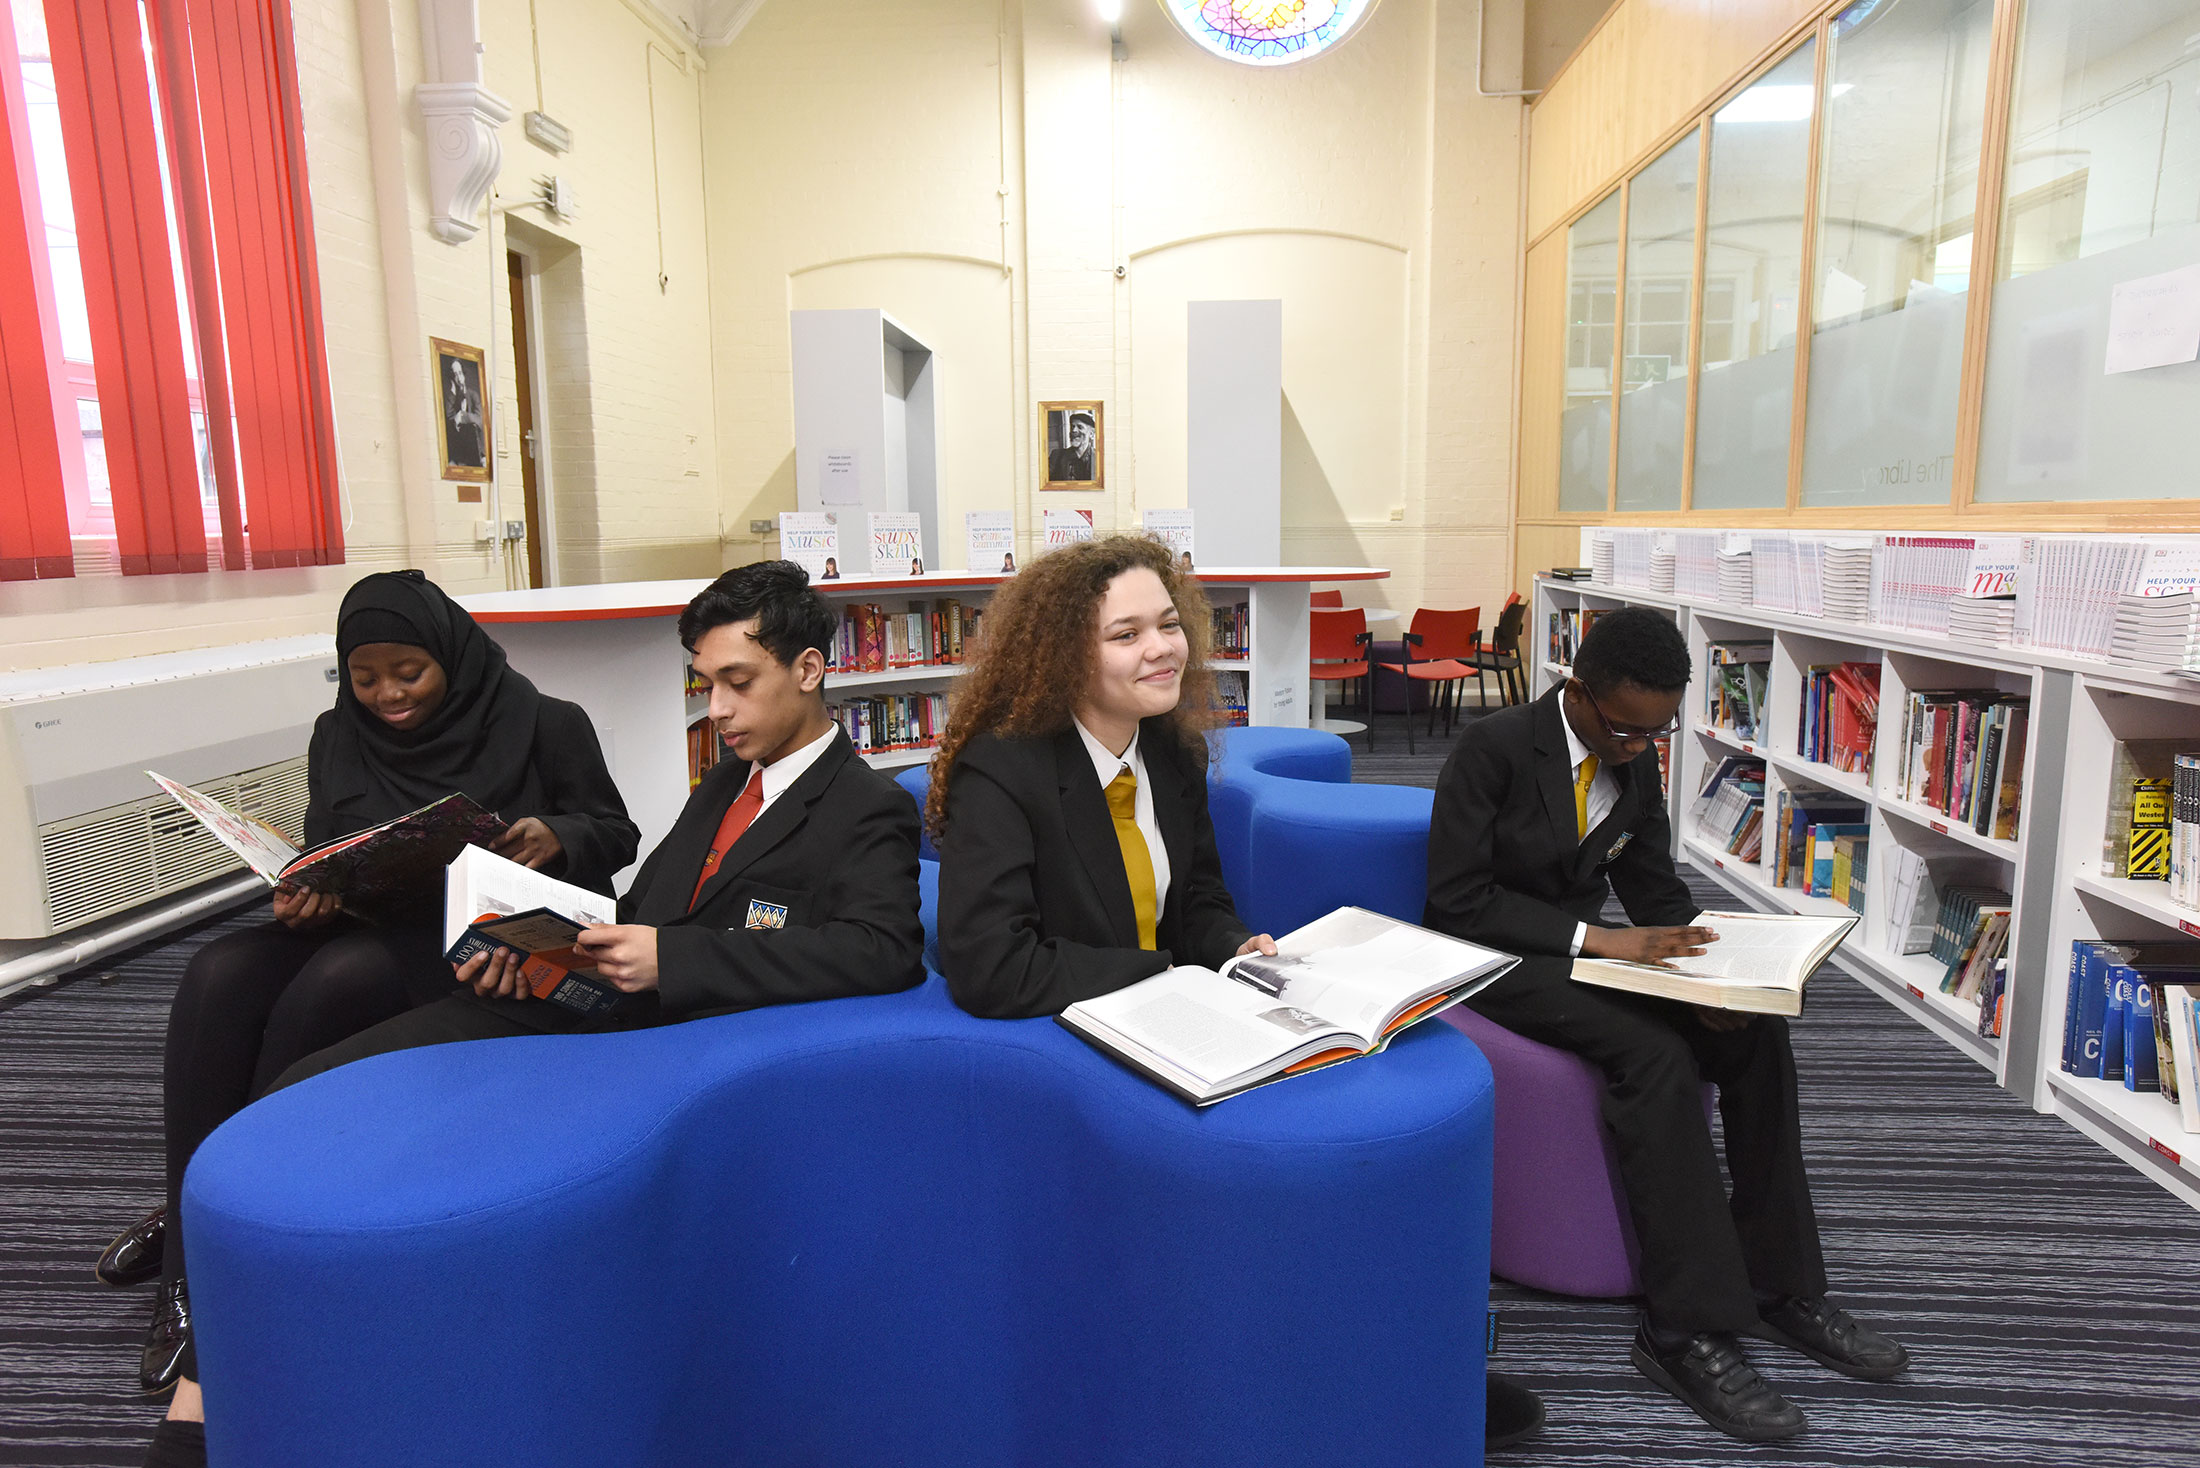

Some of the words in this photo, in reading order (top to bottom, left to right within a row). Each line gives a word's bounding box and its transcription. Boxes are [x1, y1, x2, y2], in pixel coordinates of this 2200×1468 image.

[2147, 577, 2170, 585] HELP
[2171, 576, 2197, 584] YOUR
[2080, 954, 2088, 978] COAST
